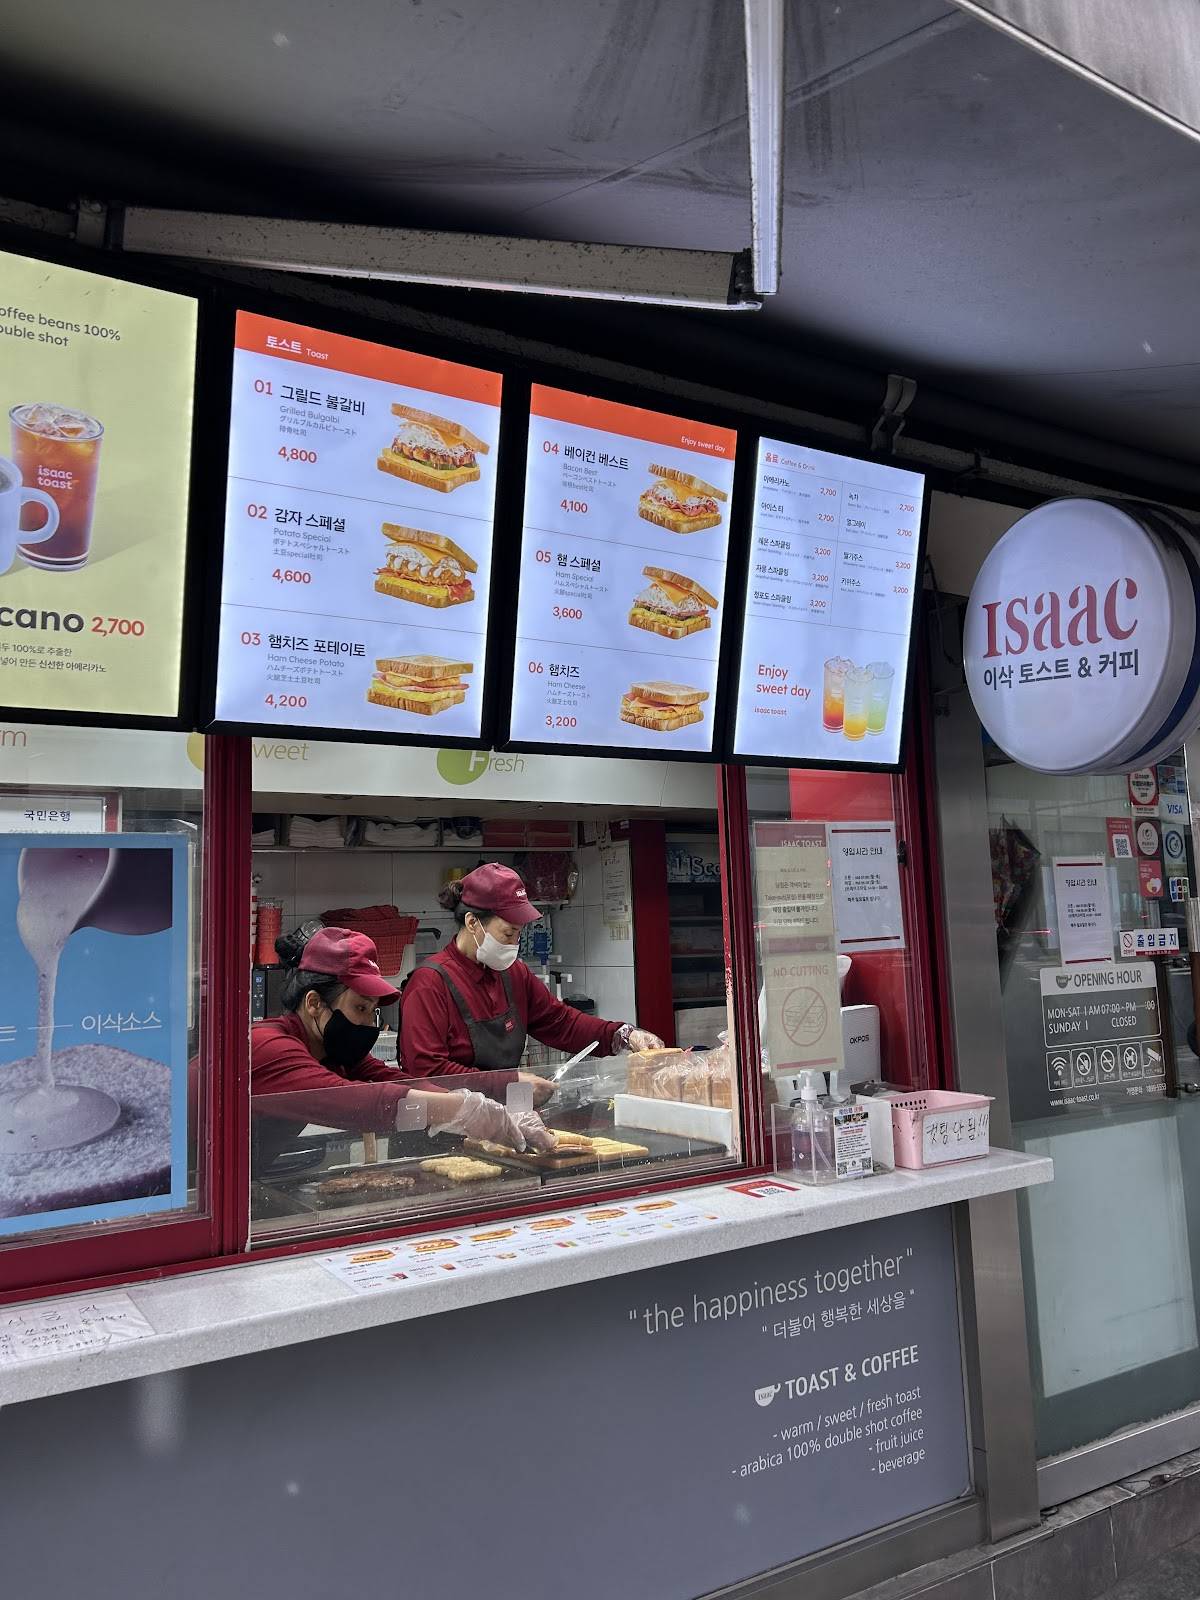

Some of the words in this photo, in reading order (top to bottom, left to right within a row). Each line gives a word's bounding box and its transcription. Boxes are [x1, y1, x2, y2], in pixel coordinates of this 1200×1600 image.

[38, 313, 80, 333] beans
[84, 324, 121, 341] 100%
[37, 332, 69, 347] shot
[266, 336, 302, 354] 토스트
[306, 349, 329, 361] Toast
[254, 379, 273, 396] 01
[280, 385, 322, 407] 그릴드
[325, 395, 366, 416] 불갈비
[279, 405, 306, 417] Grilled
[681, 436, 697, 447] Enjoy
[698, 440, 714, 451] sweet
[714, 444, 726, 453] day
[278, 446, 318, 464] 4,800
[543, 440, 560, 455] 04
[564, 445, 596, 464] 베이컨
[598, 452, 629, 470] 베스트
[765, 452, 779, 464] 음료
[38, 465, 73, 480] isaac
[37, 477, 73, 491] toast
[763, 474, 791, 488] 아메리카노
[820, 487, 837, 497] 2,700
[560, 499, 588, 514] 4,100
[899, 503, 915, 513] 2,700
[247, 504, 268, 520] 02
[274, 508, 303, 526] 감자
[305, 513, 346, 533] 스페셜
[818, 513, 835, 523] 2,700
[273, 528, 302, 539] Potato
[302, 533, 331, 544] Special
[896, 528, 912, 538] 2,700
[769, 539, 791, 550] 스파클링
[814, 546, 831, 557] 3,200
[535, 550, 551, 563] 05
[557, 553, 568, 567] 햄
[569, 557, 601, 572] 스페셜
[895, 561, 911, 570] 3,200
[271, 568, 312, 585] 4,600
[555, 571, 571, 581] Ham
[768, 566, 789, 577] 스파클링
[812, 573, 829, 583] 3,200
[809, 599, 826, 609] 3,200
[552, 606, 583, 620] 3,600
[91, 616, 145, 637] 2,700
[13, 644, 46, 655] 100%로
[241, 631, 261, 646] 03
[268, 634, 310, 652] 햄치즈
[313, 640, 366, 658] 포테이토
[39, 660, 64, 671] 신선한
[65, 662, 107, 673] 아메리카노
[267, 653, 287, 663] Ham
[289, 656, 318, 666] Cheese
[319, 658, 345, 668] Potato
[528, 661, 544, 674] 06
[549, 663, 580, 678] 햄치즈
[757, 664, 788, 681] Enjoy
[983, 664, 1014, 690] 이삭
[1018, 658, 1072, 684] 토스트
[1078, 656, 1093, 678] &
[1098, 649, 1139, 677] 커피
[756, 683, 788, 695] sweet
[790, 686, 811, 700] day
[264, 694, 307, 709] 4,200
[545, 715, 577, 729] 3,200
[24, 809, 71, 822] 국민은행
[1167, 803, 1183, 815] VISA
[781, 840, 800, 848] ISAAC
[802, 839, 822, 848] TOAST
[843, 847, 868, 857] 영업시간
[870, 847, 883, 856] 안내
[1136, 933, 1177, 948] 출입금지
[773, 967, 788, 977] NO
[789, 965, 829, 977] CUTTING
[1073, 971, 1115, 988] OPENING
[1116, 969, 1143, 985] HOUR
[1047, 1006, 1081, 1020] MON-SAT
[81, 1010, 163, 1035] 이삭소스
[1049, 1020, 1082, 1034] SUNDAY
[1111, 1015, 1137, 1028] CLOSED
[850, 1034, 870, 1044] OKPOS
[953, 1121, 965, 1142] 안
[643, 1304, 684, 1335] the
[693, 1277, 808, 1324] happiness
[814, 1254, 903, 1294] together
[773, 1313, 816, 1340] 더불어
[821, 1303, 862, 1328] 행복한
[867, 1291, 906, 1316] 세상을
[785, 1367, 839, 1399] TOAST
[844, 1363, 857, 1382] &
[861, 1345, 919, 1378] COFFEE
[781, 1419, 814, 1441] warm
[824, 1405, 857, 1427] sweet
[867, 1394, 893, 1415] fresh
[895, 1385, 921, 1405] toast
[740, 1452, 783, 1477] arabica
[787, 1439, 821, 1461] 100%
[824, 1426, 862, 1449] double
[865, 1417, 888, 1437] shot
[890, 1407, 923, 1428] coffee
[875, 1434, 898, 1455] fruit
[899, 1427, 924, 1448] juice
[878, 1448, 926, 1474] beverage
